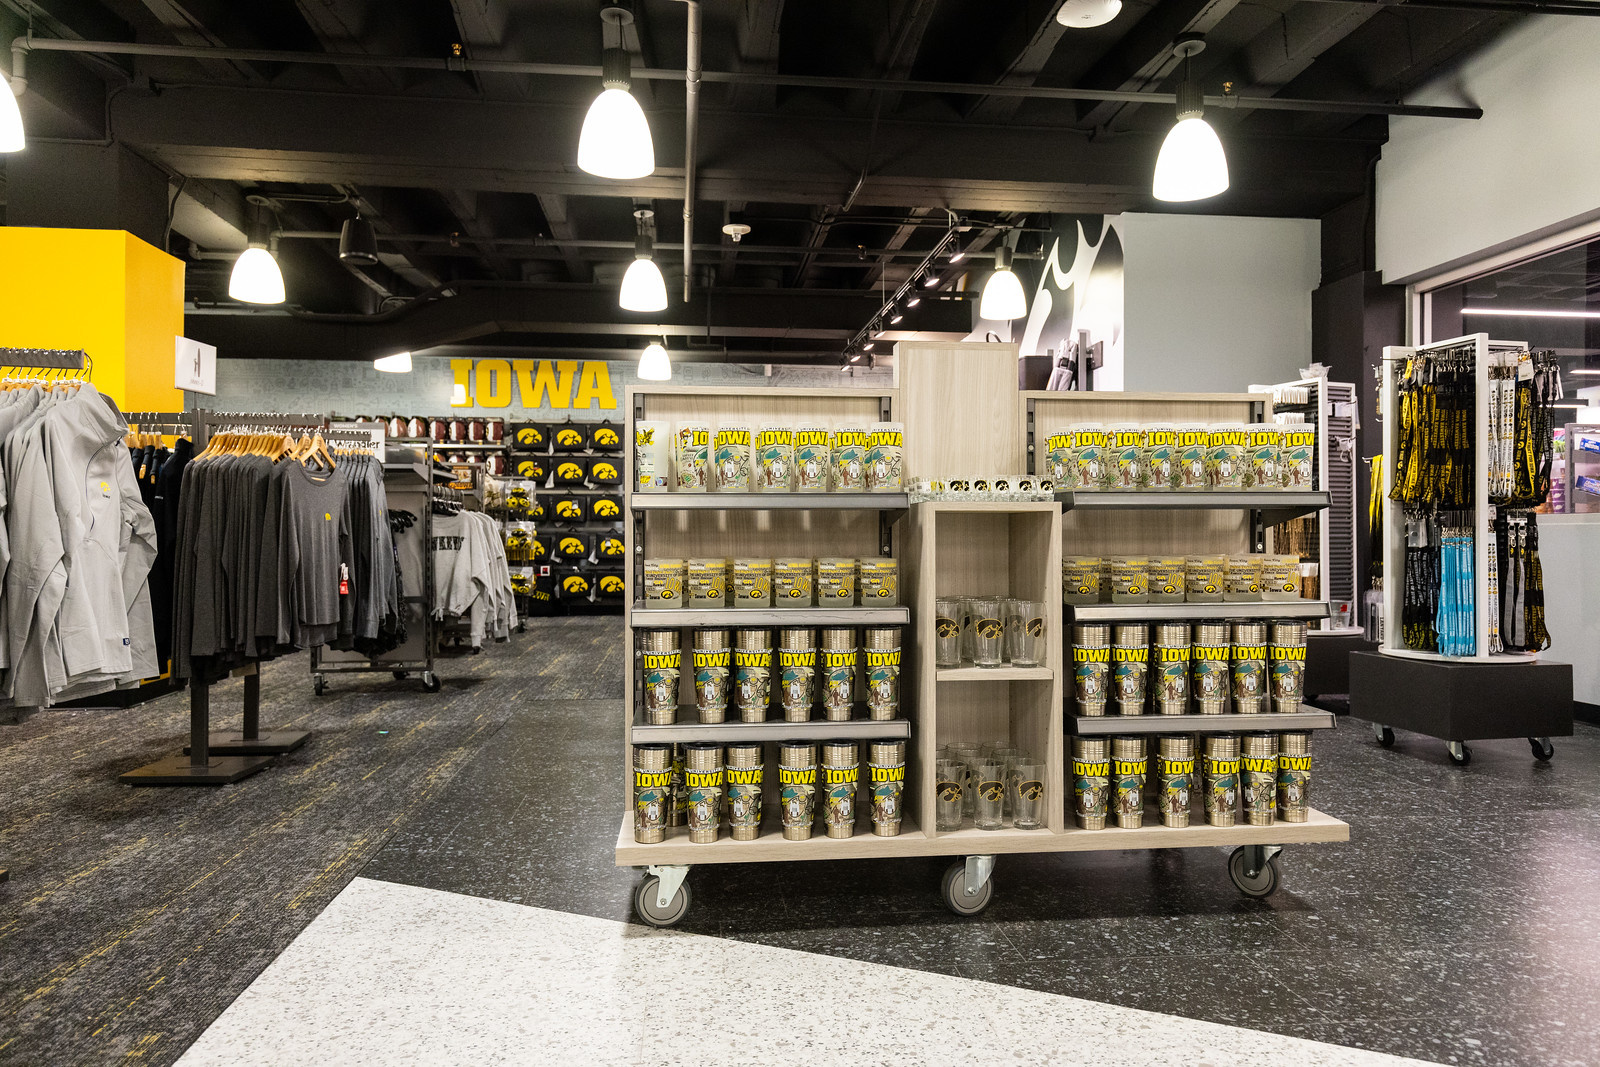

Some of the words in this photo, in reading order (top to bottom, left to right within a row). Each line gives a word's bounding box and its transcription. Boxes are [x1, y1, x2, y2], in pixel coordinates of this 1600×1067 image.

[450, 359, 617, 409] IOWA
[760, 431, 793, 447] IOW
[836, 432, 866, 448] IOW
[1285, 432, 1315, 448] IOW
[693, 652, 730, 667] IOWA
[779, 652, 816, 667] IOWA
[825, 652, 857, 667] IOW
[1073, 648, 1110, 662] IOWA
[1112, 648, 1149, 662] IOWA
[1161, 648, 1191, 662] IOW
[1192, 646, 1230, 660] IOWA
[1115, 760, 1147, 775] IOW
[1164, 760, 1195, 775] IOW
[1211, 759, 1240, 775] IOW
[685, 771, 724, 788] IOWA
[778, 768, 817, 784] IOWA
[826, 768, 858, 784] IOW
